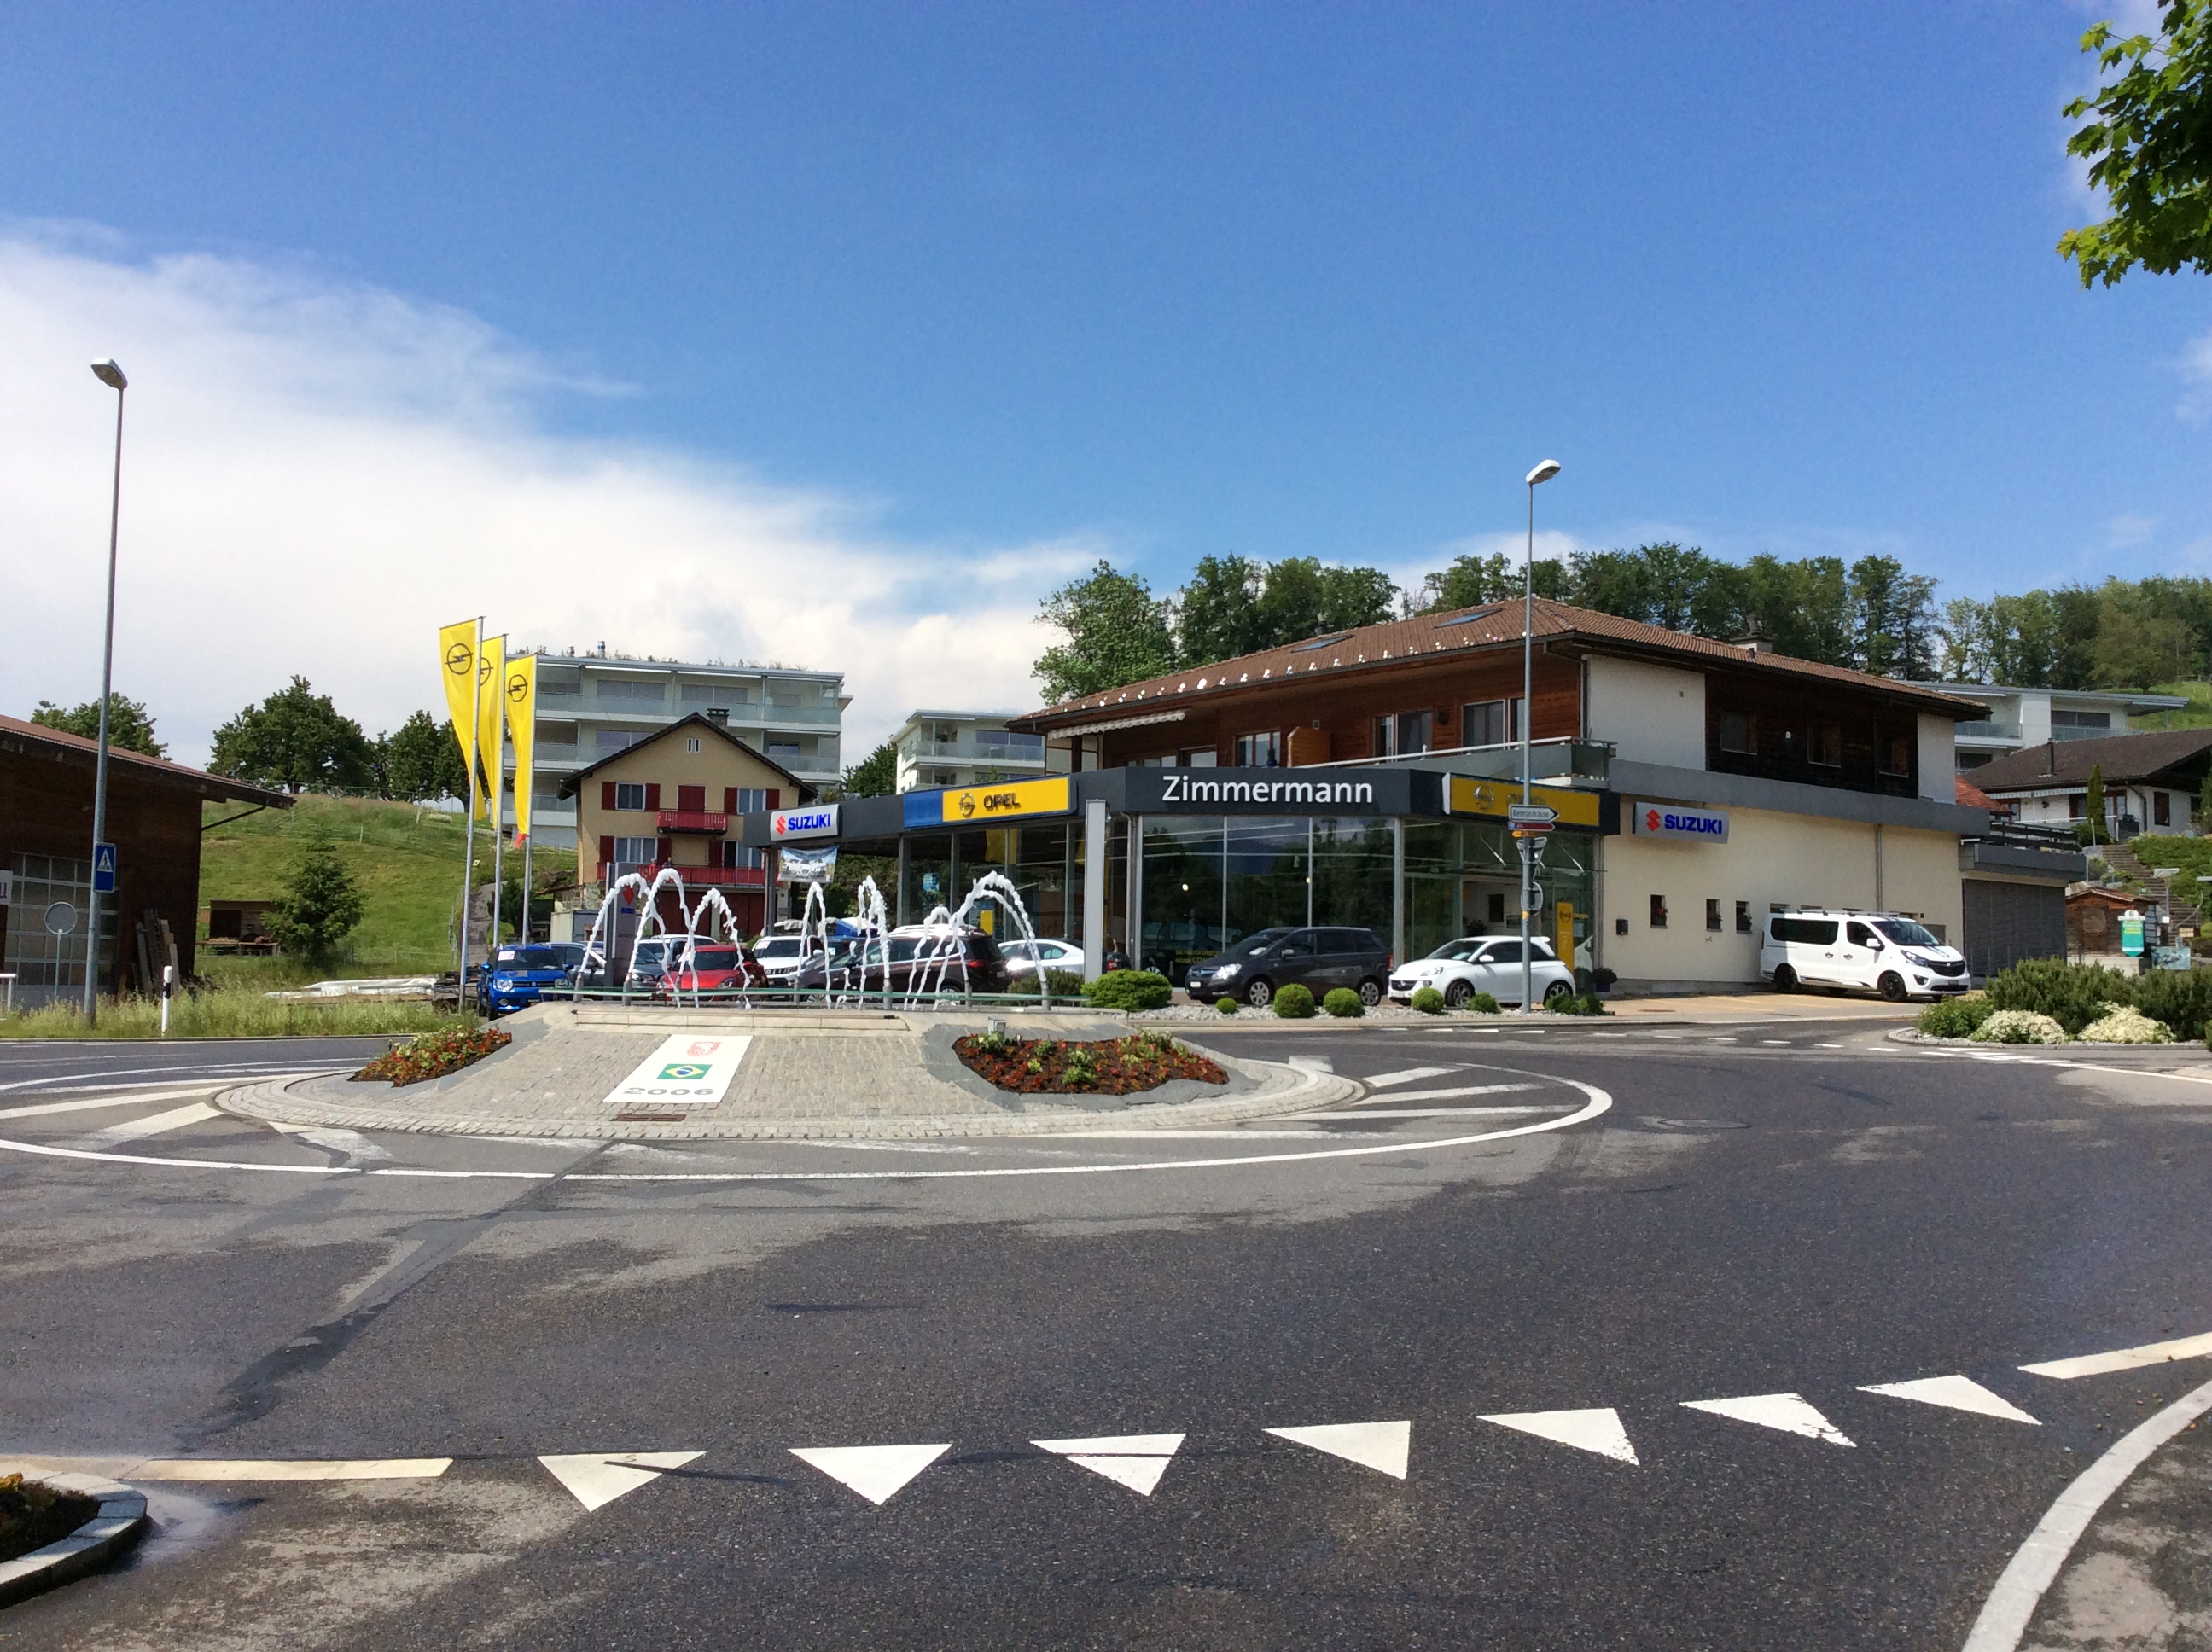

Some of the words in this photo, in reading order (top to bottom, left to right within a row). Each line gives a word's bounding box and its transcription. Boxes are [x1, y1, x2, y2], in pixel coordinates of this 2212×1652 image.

[1162, 775, 1372, 803] Zimmermann
[983, 793, 1020, 809] OPEL
[787, 813, 831, 831] SUZUKI
[1664, 814, 1722, 835] SUZUKI
[623, 1087, 714, 1096] 2006
